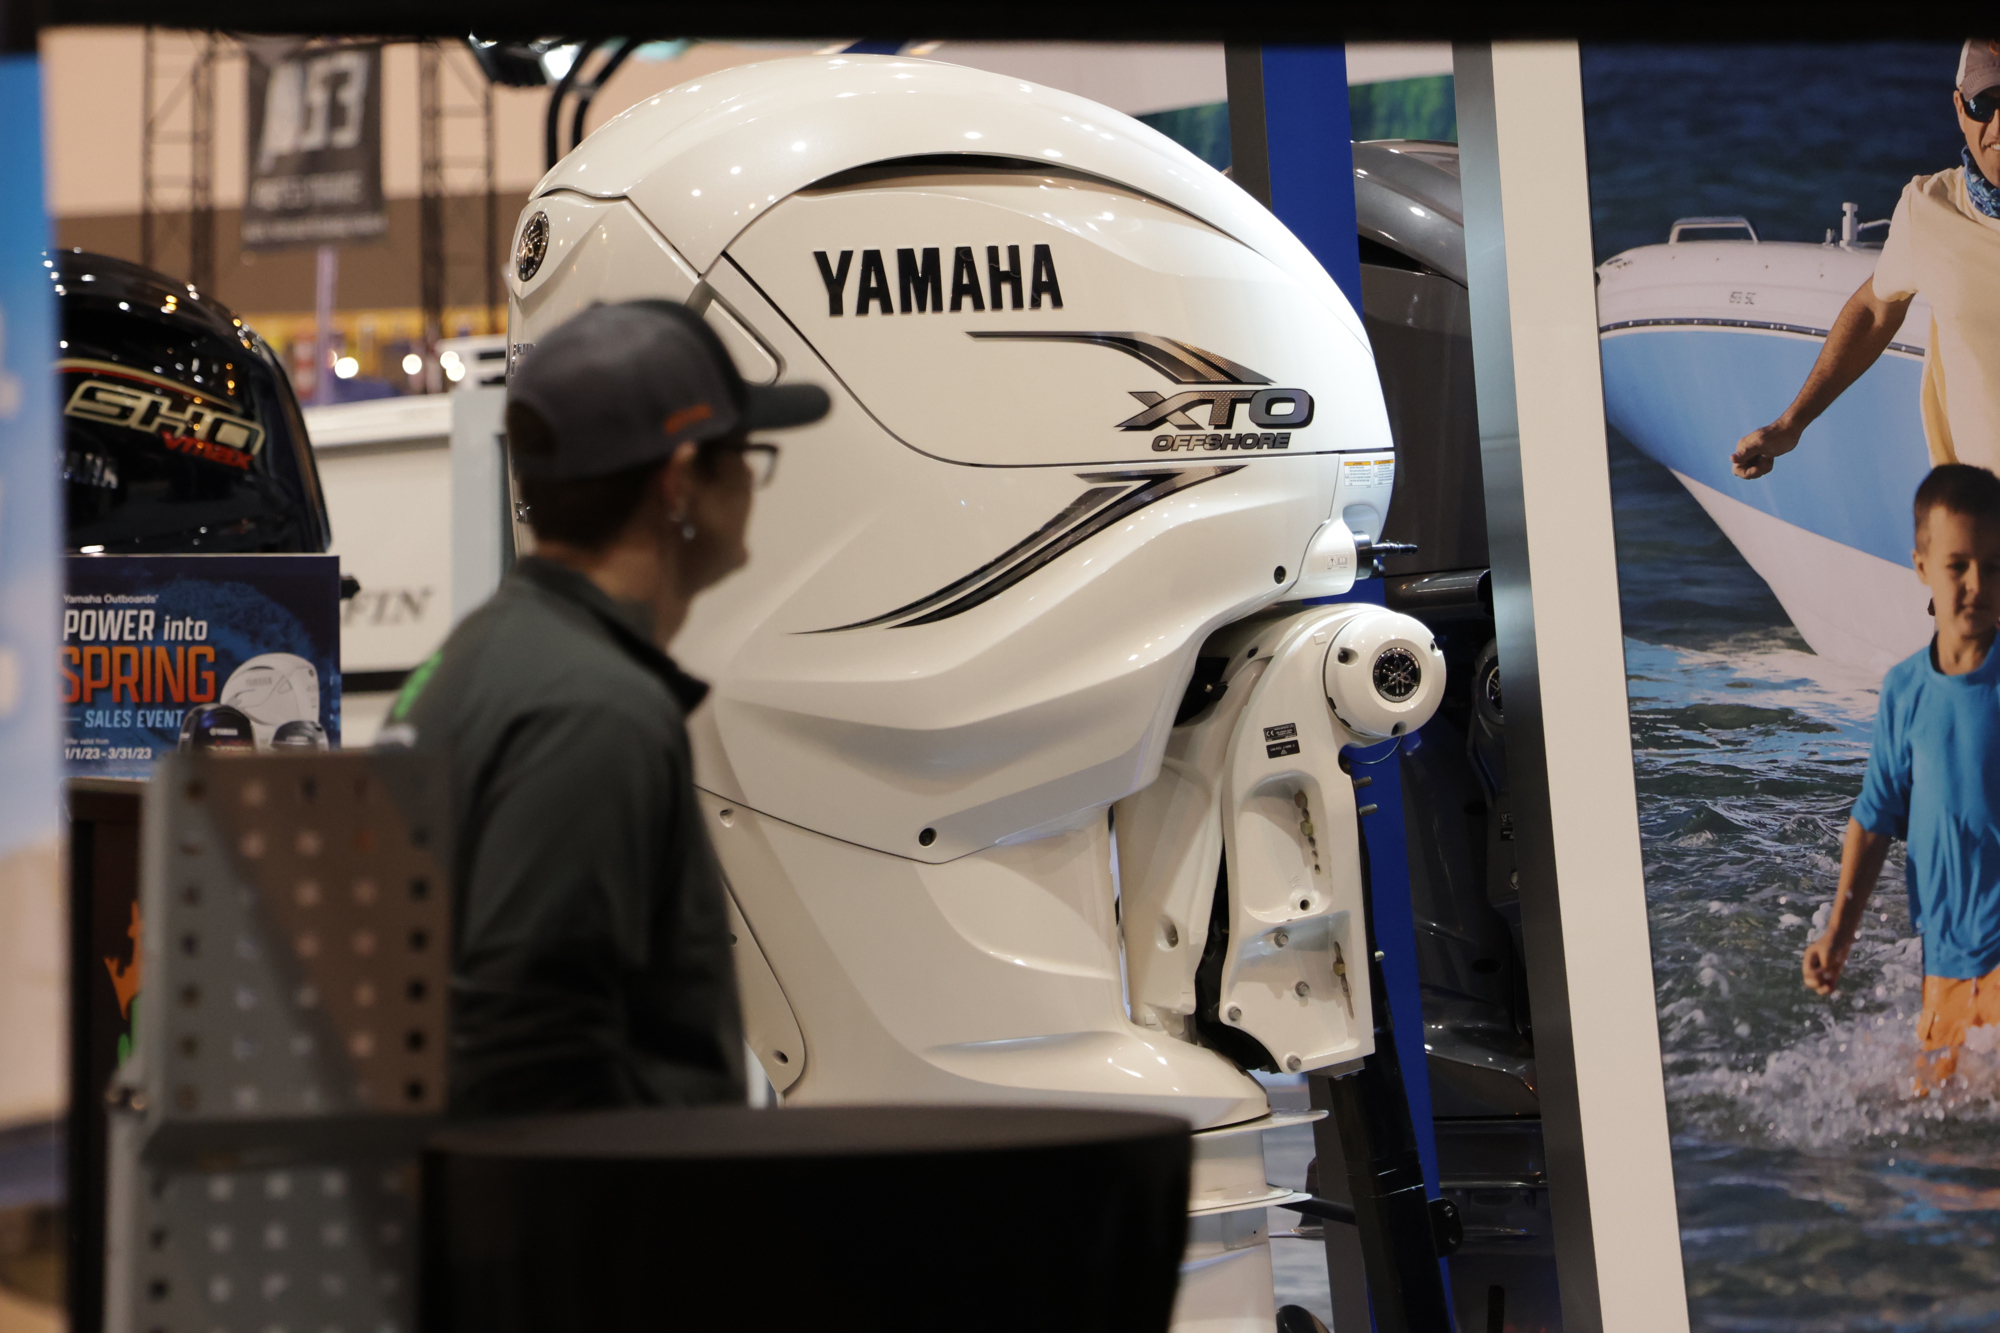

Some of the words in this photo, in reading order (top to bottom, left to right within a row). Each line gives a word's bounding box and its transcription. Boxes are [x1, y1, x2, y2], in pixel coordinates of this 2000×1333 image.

[813, 243, 1064, 317] YAMAHA
[64, 380, 266, 455] SHO
[1114, 388, 1315, 432] XTO
[1152, 432, 1292, 452] OFFSHORE
[63, 594, 102, 604] Yamaha
[63, 609, 156, 641] POWER
[163, 614, 208, 641] into
[58, 645, 216, 703] SPRING
[84, 709, 132, 728] SALES
[136, 709, 185, 728] EVENT
